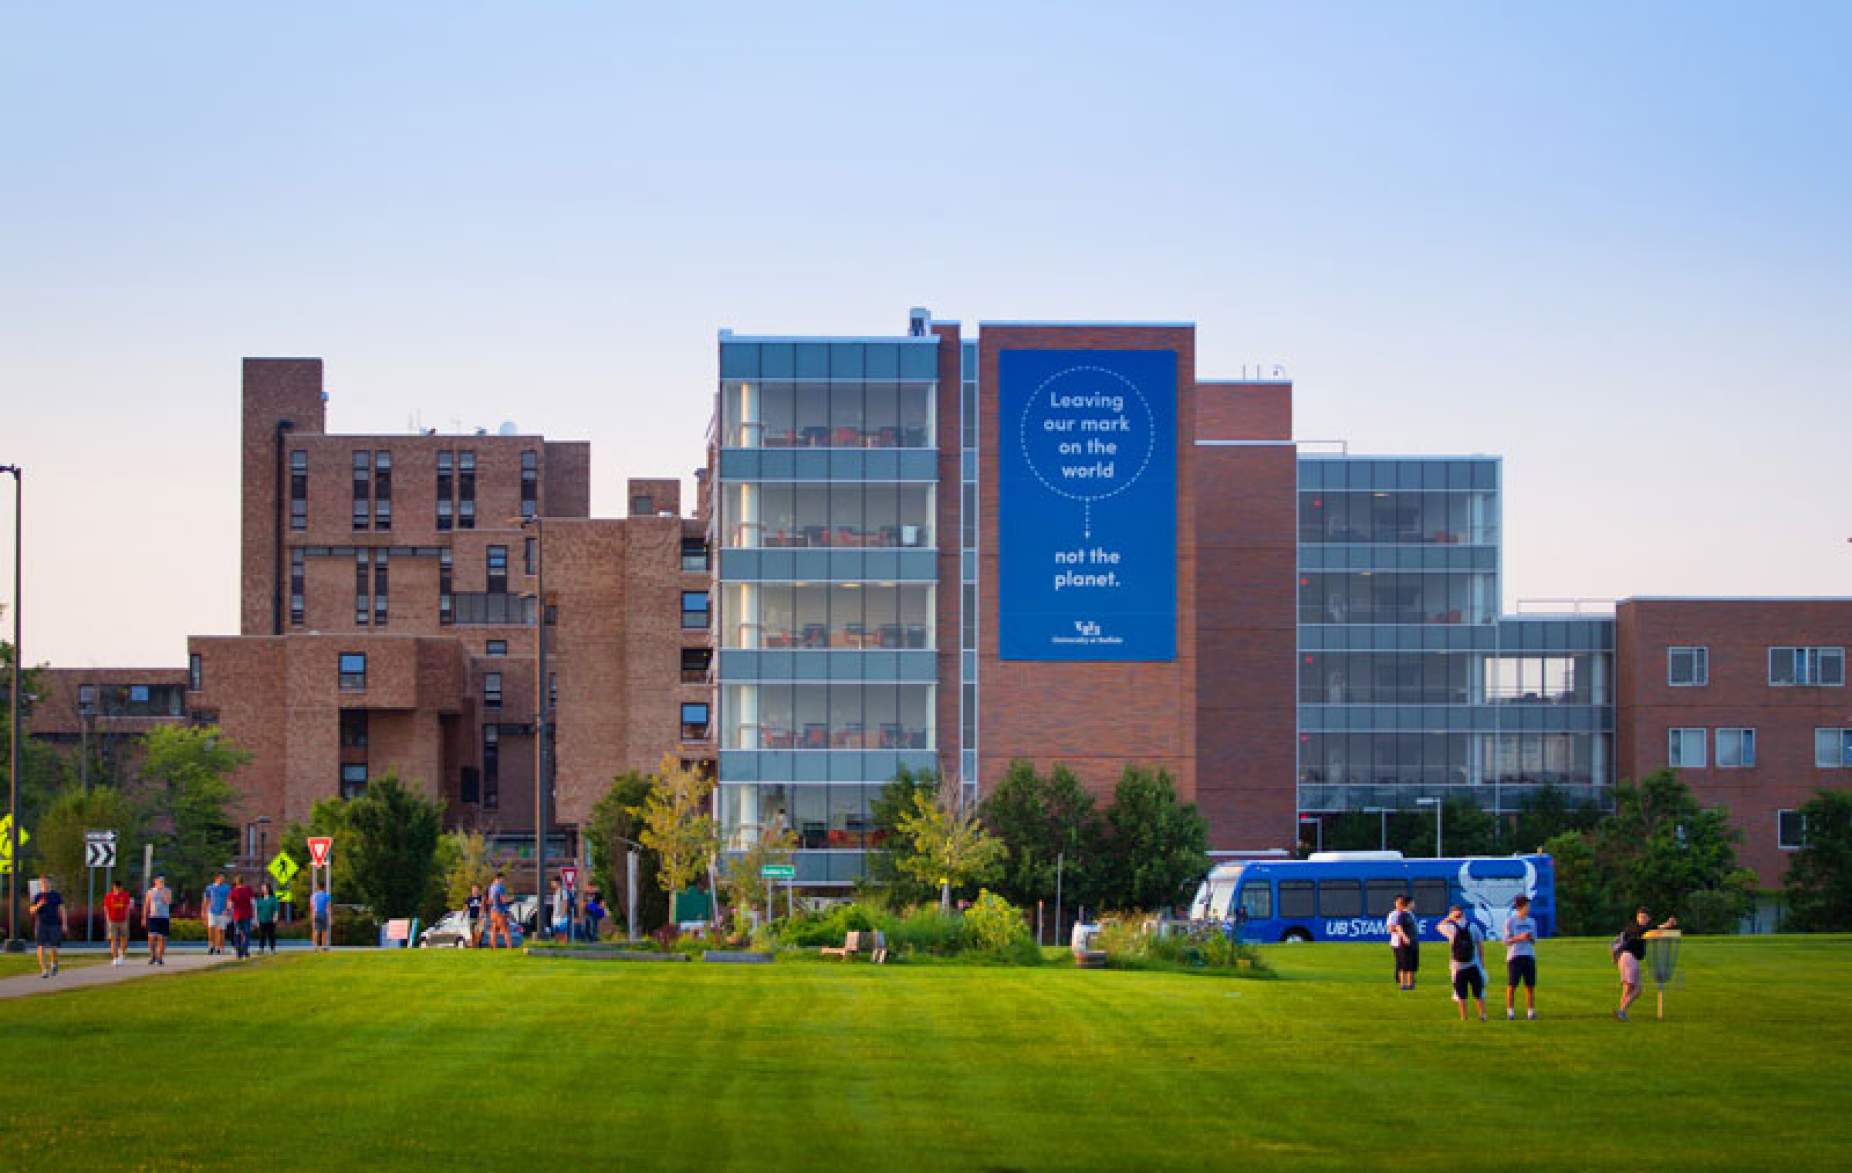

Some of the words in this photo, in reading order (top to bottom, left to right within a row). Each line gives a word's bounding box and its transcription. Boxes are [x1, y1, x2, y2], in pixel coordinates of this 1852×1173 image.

[1050, 391, 1124, 413] Leaving
[1043, 418, 1075, 432] our
[1081, 415, 1130, 432] mark
[1059, 442, 1082, 455] on
[1087, 437, 1118, 455] the
[1062, 461, 1115, 479] world
[1055, 549, 1085, 564] not
[1089, 546, 1121, 564] the
[1055, 569, 1121, 592] planet.
[1325, 919, 1348, 935] UB
[1348, 918, 1427, 937] STAME
